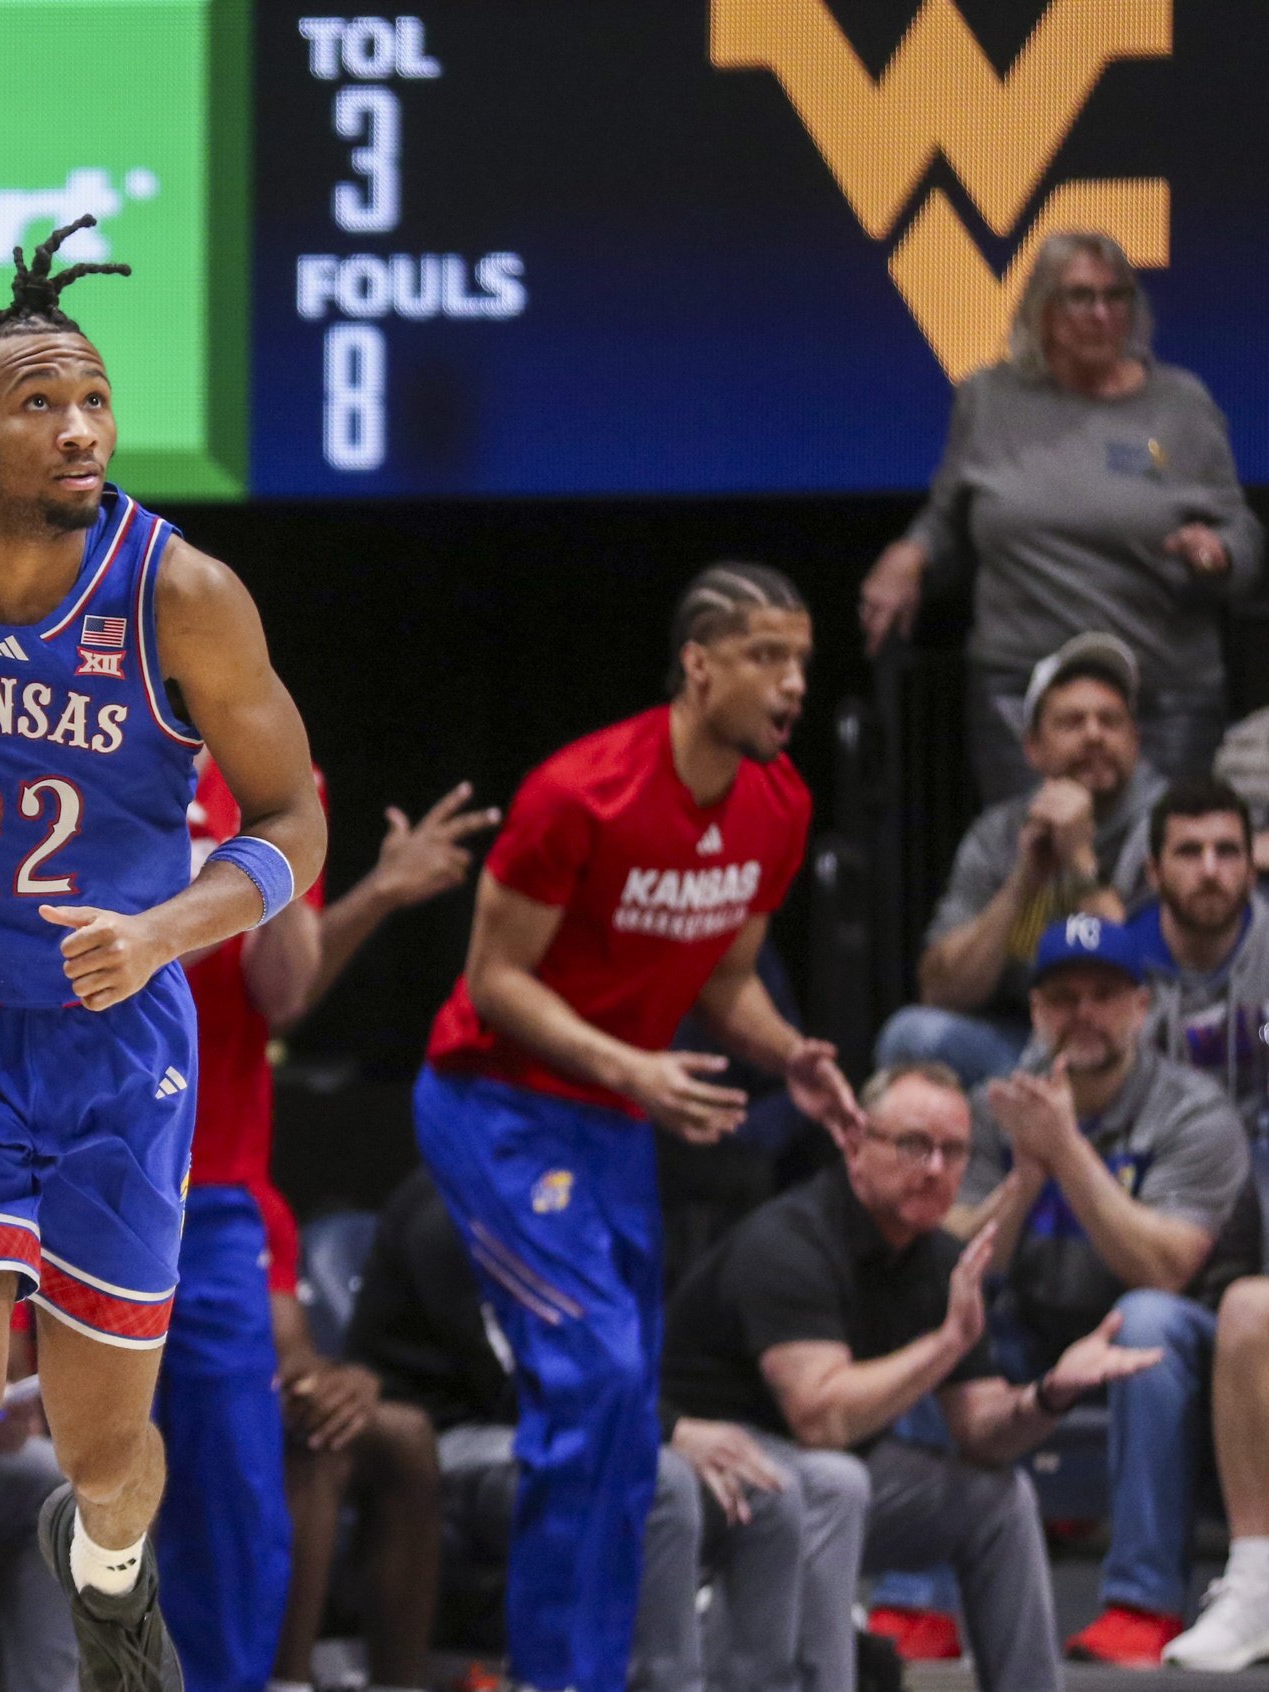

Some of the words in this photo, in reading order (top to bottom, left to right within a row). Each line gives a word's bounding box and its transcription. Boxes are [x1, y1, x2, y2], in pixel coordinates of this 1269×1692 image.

[298, 17, 441, 80] TOL
[333, 85, 402, 234] 3
[296, 253, 528, 319] FOULS
[322, 323, 386, 472] 8
[77, 649, 123, 678] XII
[620, 859, 762, 910] KANSAS
